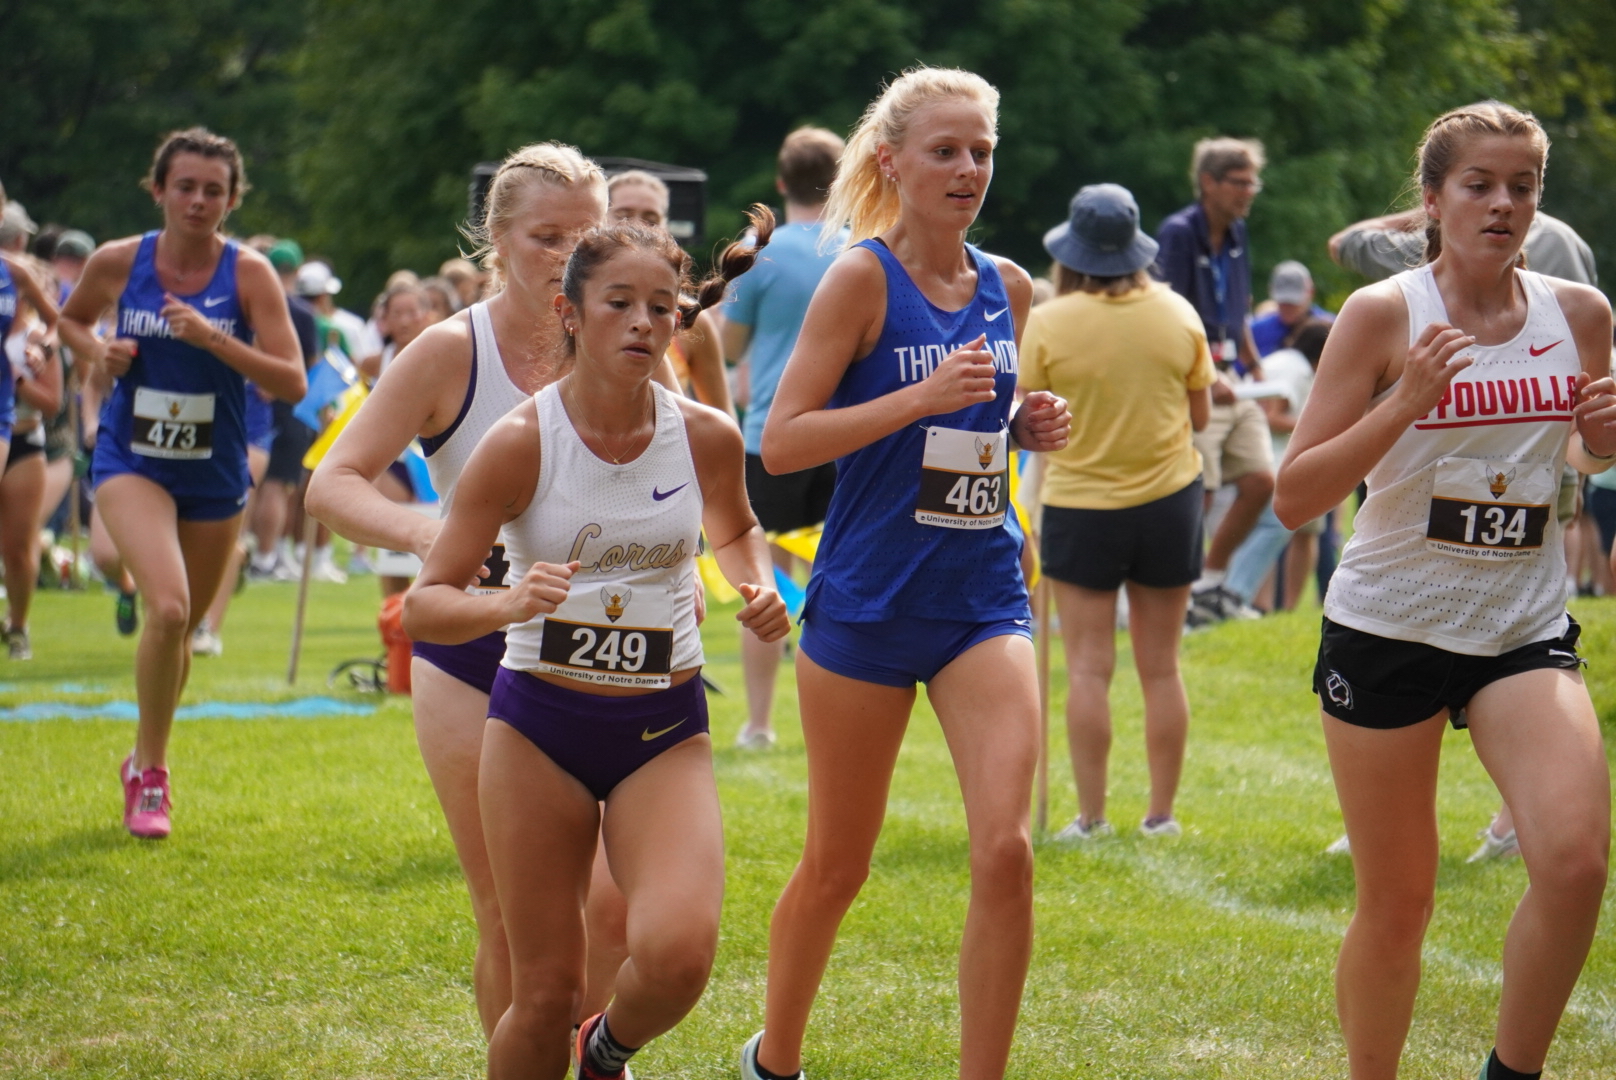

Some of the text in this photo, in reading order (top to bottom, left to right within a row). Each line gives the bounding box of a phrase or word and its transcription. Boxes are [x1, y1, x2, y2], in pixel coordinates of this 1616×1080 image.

[123, 308, 175, 339] THOMA
[984, 340, 1018, 375] MOR
[1417, 375, 1577, 420] YOUVILLE
[147, 420, 197, 450] 473
[945, 475, 1001, 515] 463
[926, 515, 967, 526] University
[969, 518, 977, 526] of
[1460, 505, 1527, 546] 134
[566, 522, 687, 573] Loras
[1437, 543, 1480, 557] University
[1492, 550, 1513, 558] Notre
[568, 627, 647, 672] 249
[549, 666, 594, 681] University
[608, 675, 633, 684] Notre
[635, 677, 659, 685] Dame
